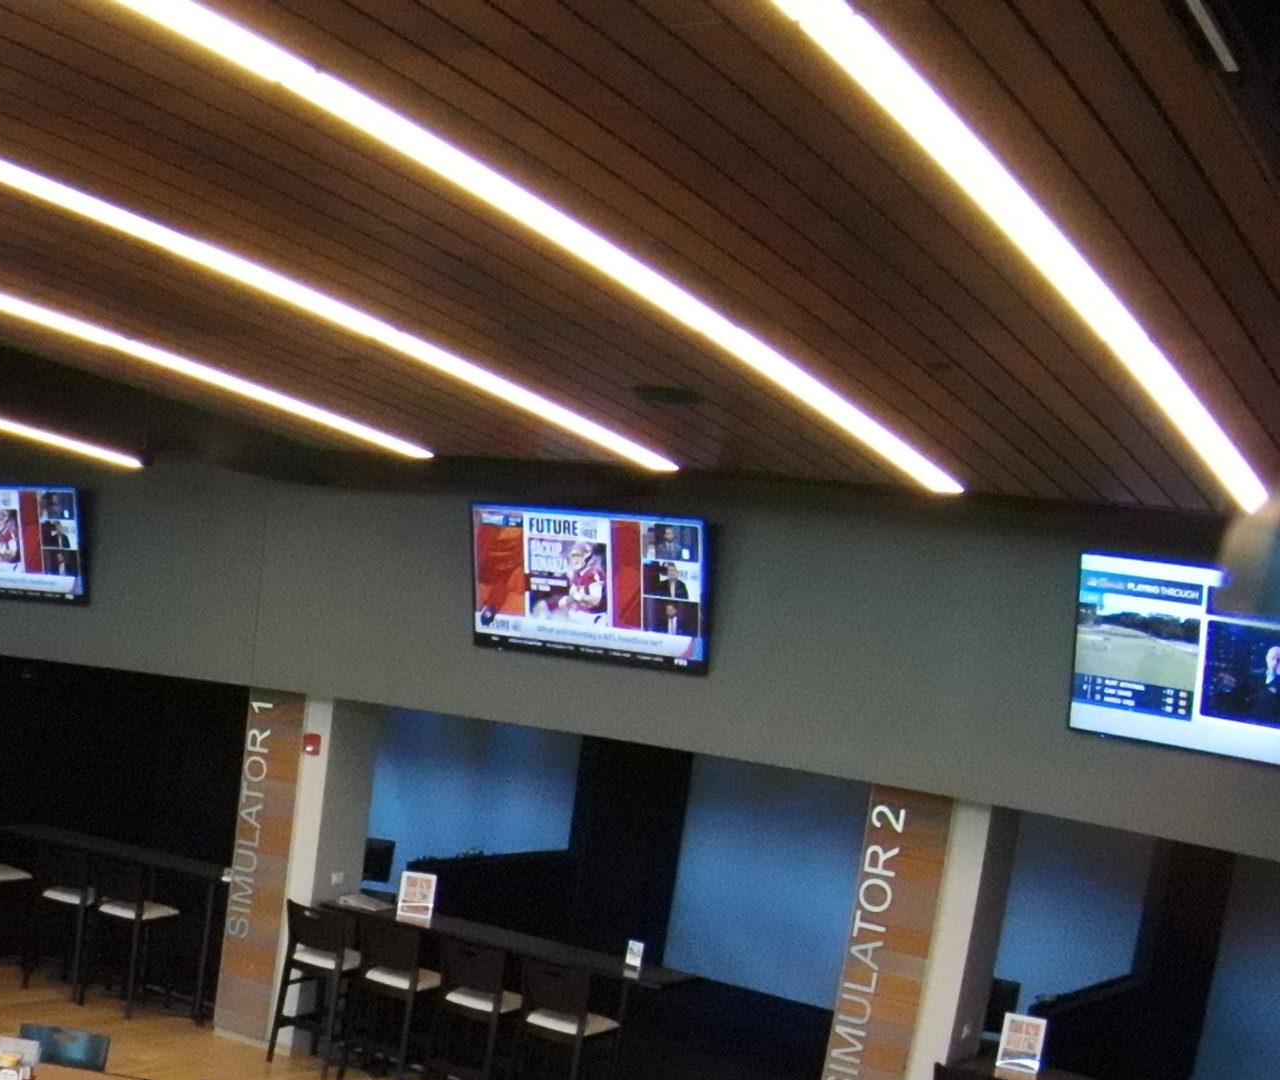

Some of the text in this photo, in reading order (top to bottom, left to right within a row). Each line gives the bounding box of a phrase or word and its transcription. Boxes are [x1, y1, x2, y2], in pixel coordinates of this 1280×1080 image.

[528, 517, 579, 536] FUTURE
[228, 701, 274, 938] SIMULATOR 1
[871, 804, 906, 833] 2
